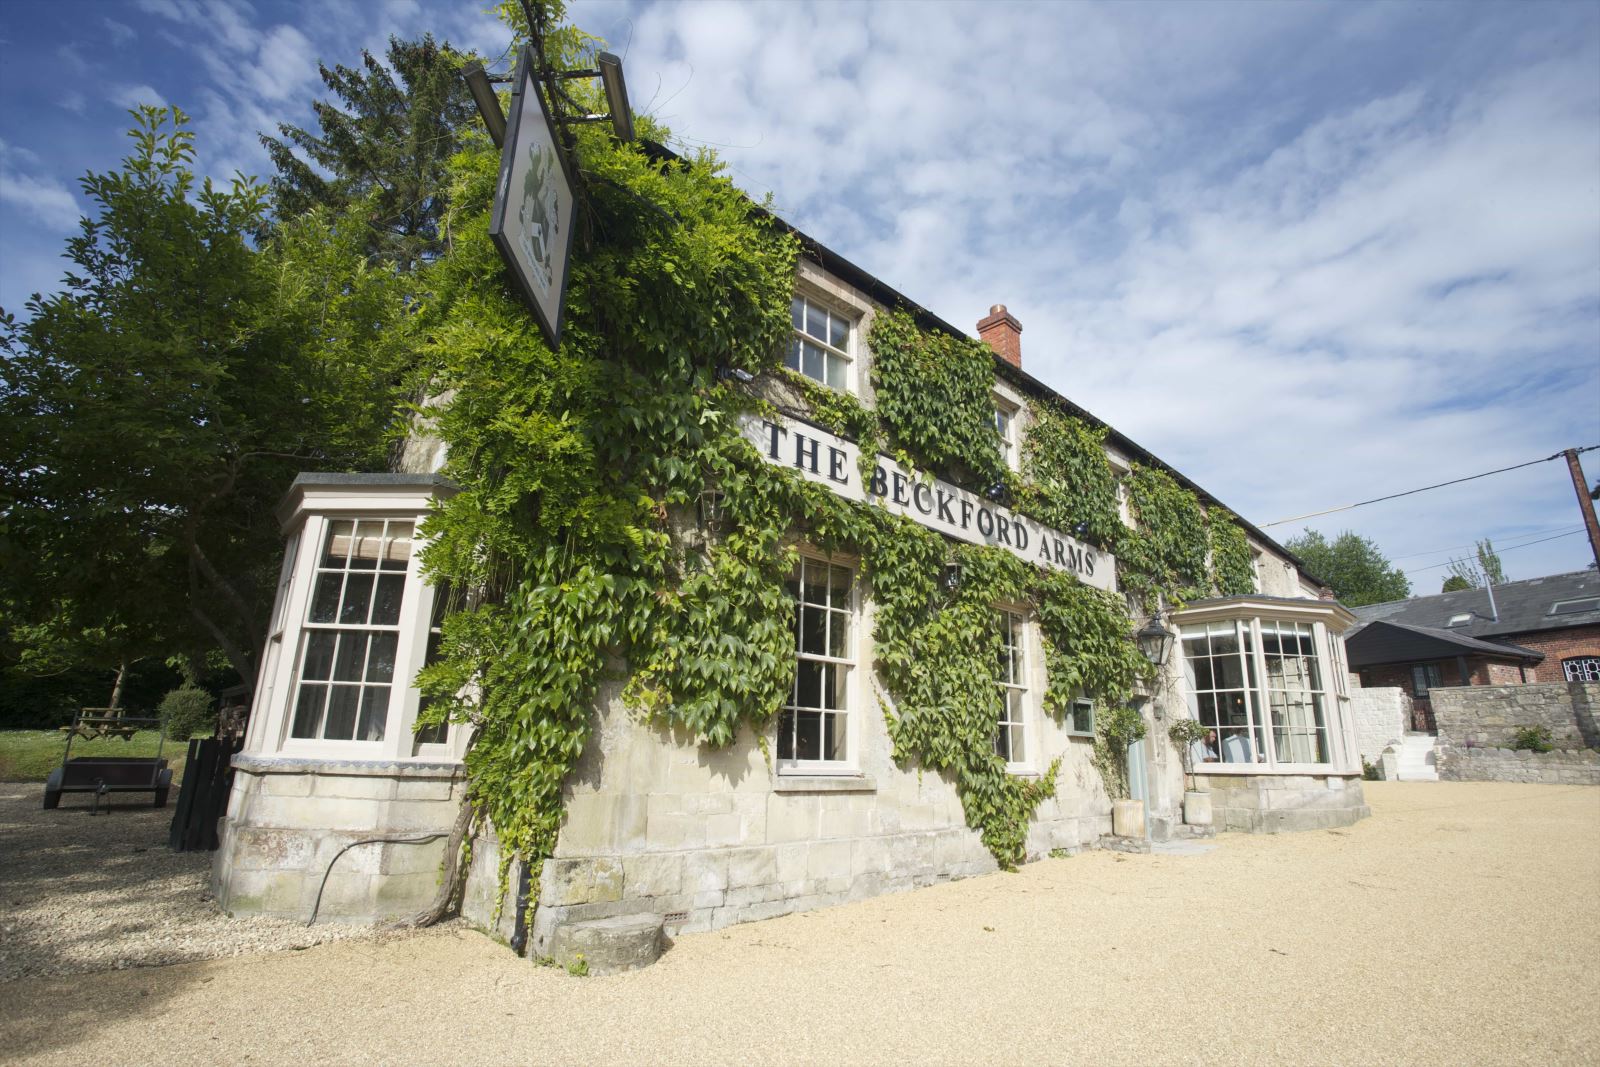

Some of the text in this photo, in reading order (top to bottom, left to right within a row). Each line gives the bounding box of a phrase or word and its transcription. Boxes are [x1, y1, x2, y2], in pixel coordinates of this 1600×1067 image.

[763, 421, 1095, 578] THE BECKFORD ARMS
